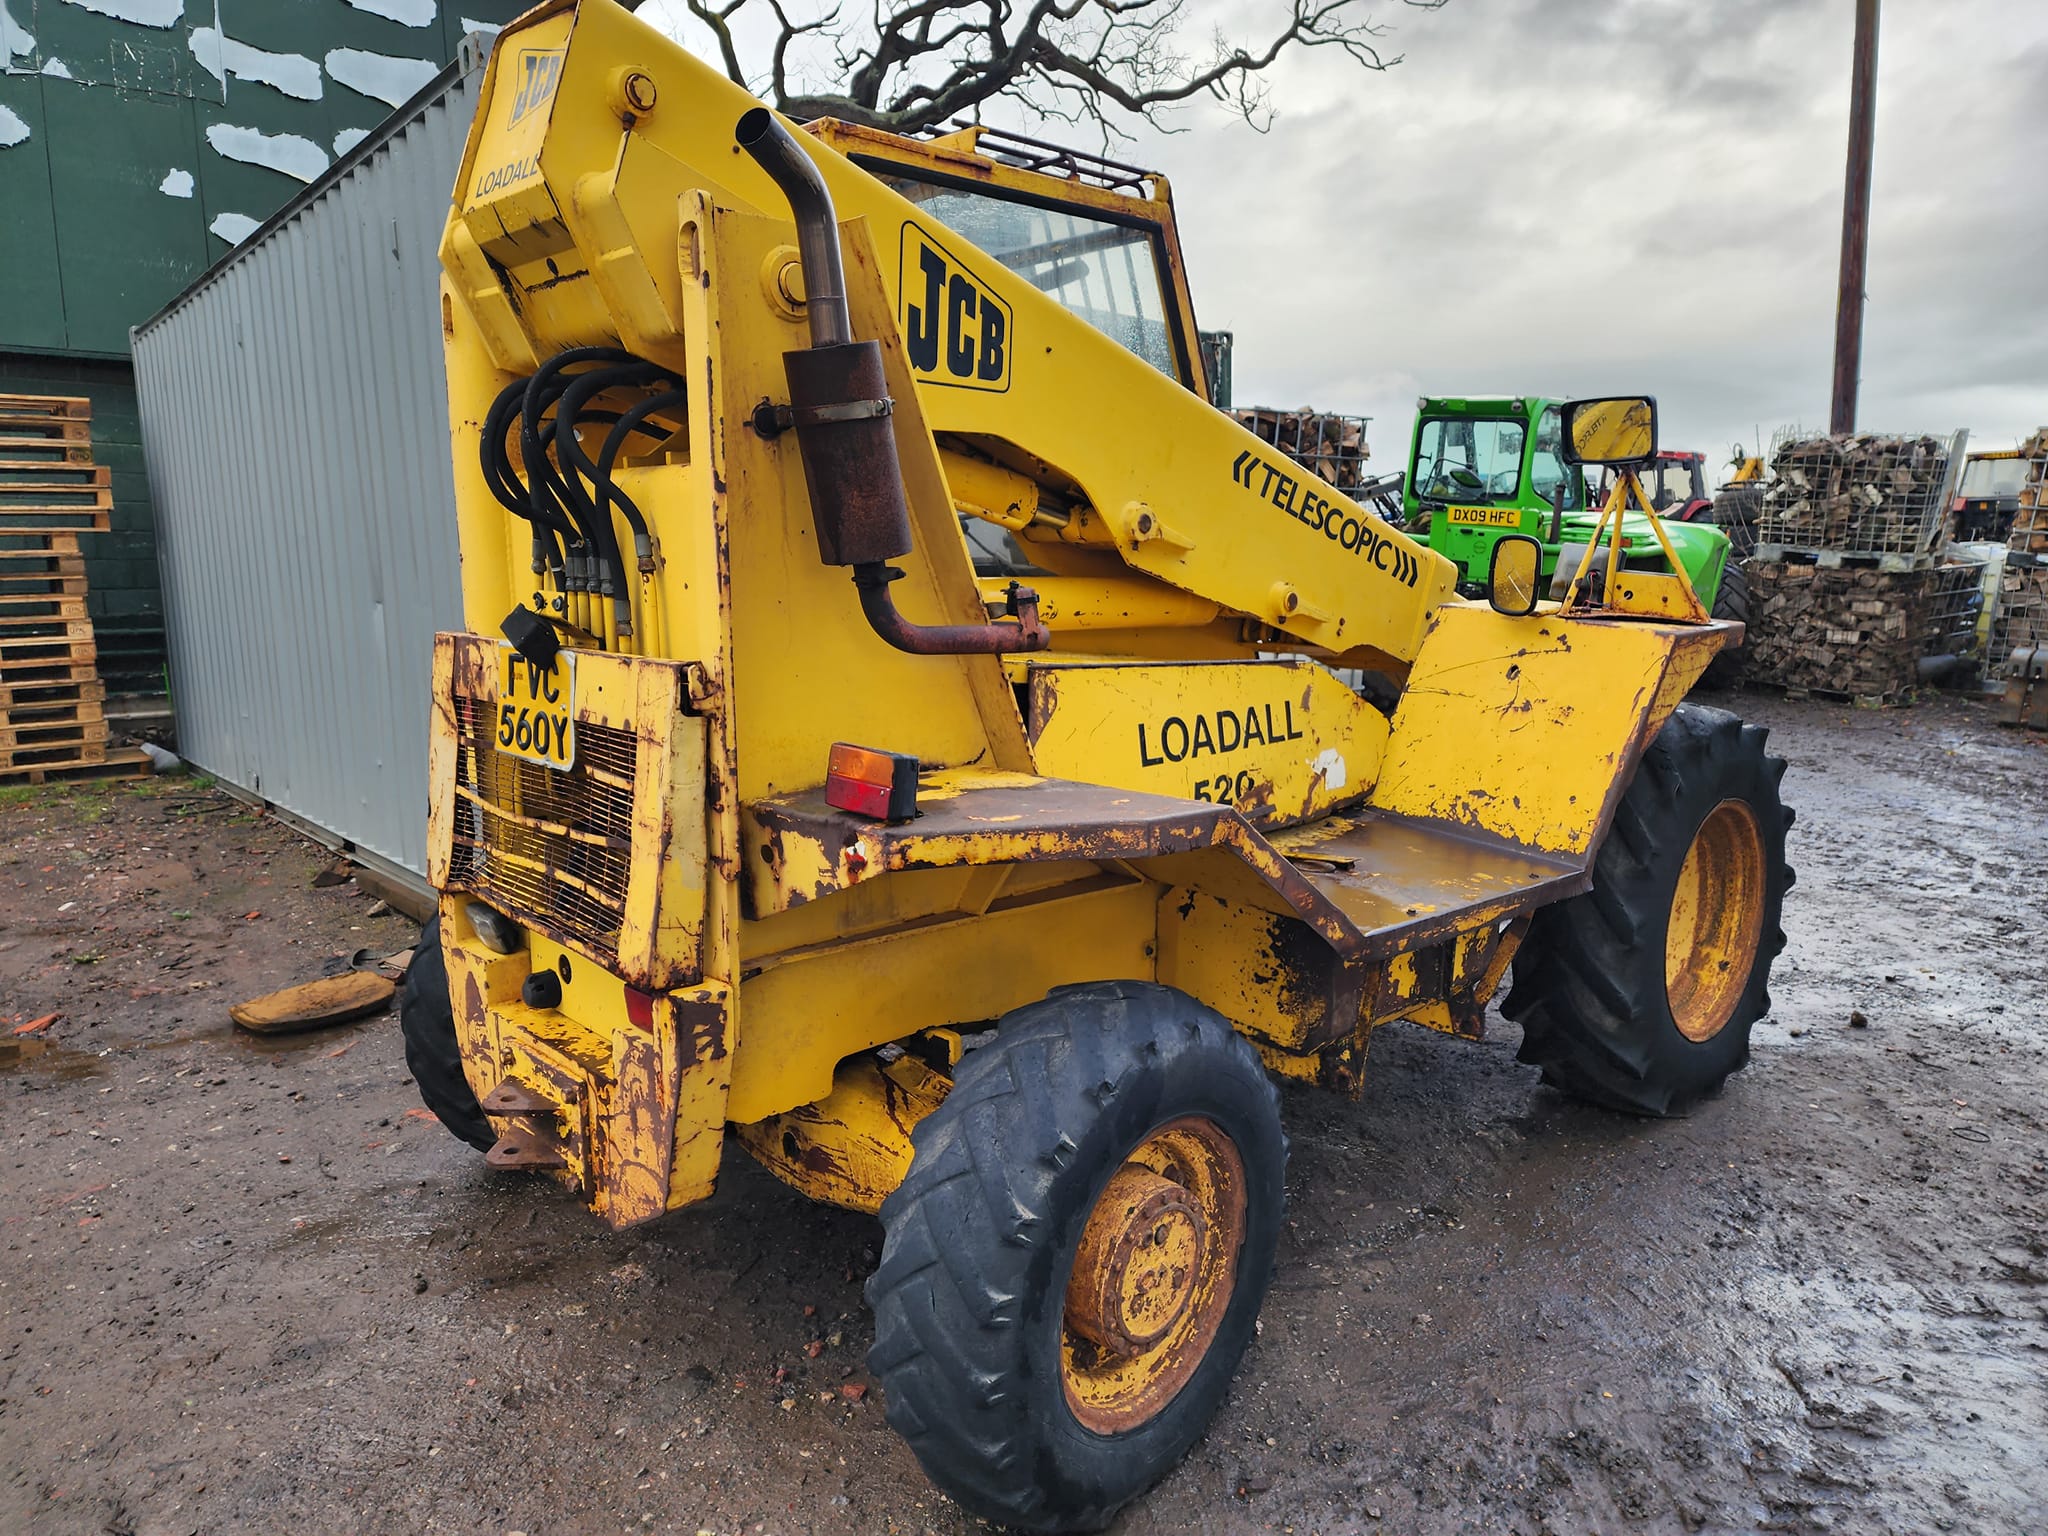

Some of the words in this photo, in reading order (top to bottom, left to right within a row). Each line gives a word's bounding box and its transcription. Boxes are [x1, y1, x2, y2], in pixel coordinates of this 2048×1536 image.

[511, 56, 561, 123] JCB
[475, 154, 538, 198] LOADALL
[908, 242, 1005, 381] JCB
[1260, 462, 1392, 570] TELESCOPIC
[1453, 509, 1486, 522] DX09
[1490, 511, 1515, 524] HFC
[499, 704, 567, 760] 560Y
[1138, 700, 1303, 767] LOADALL
